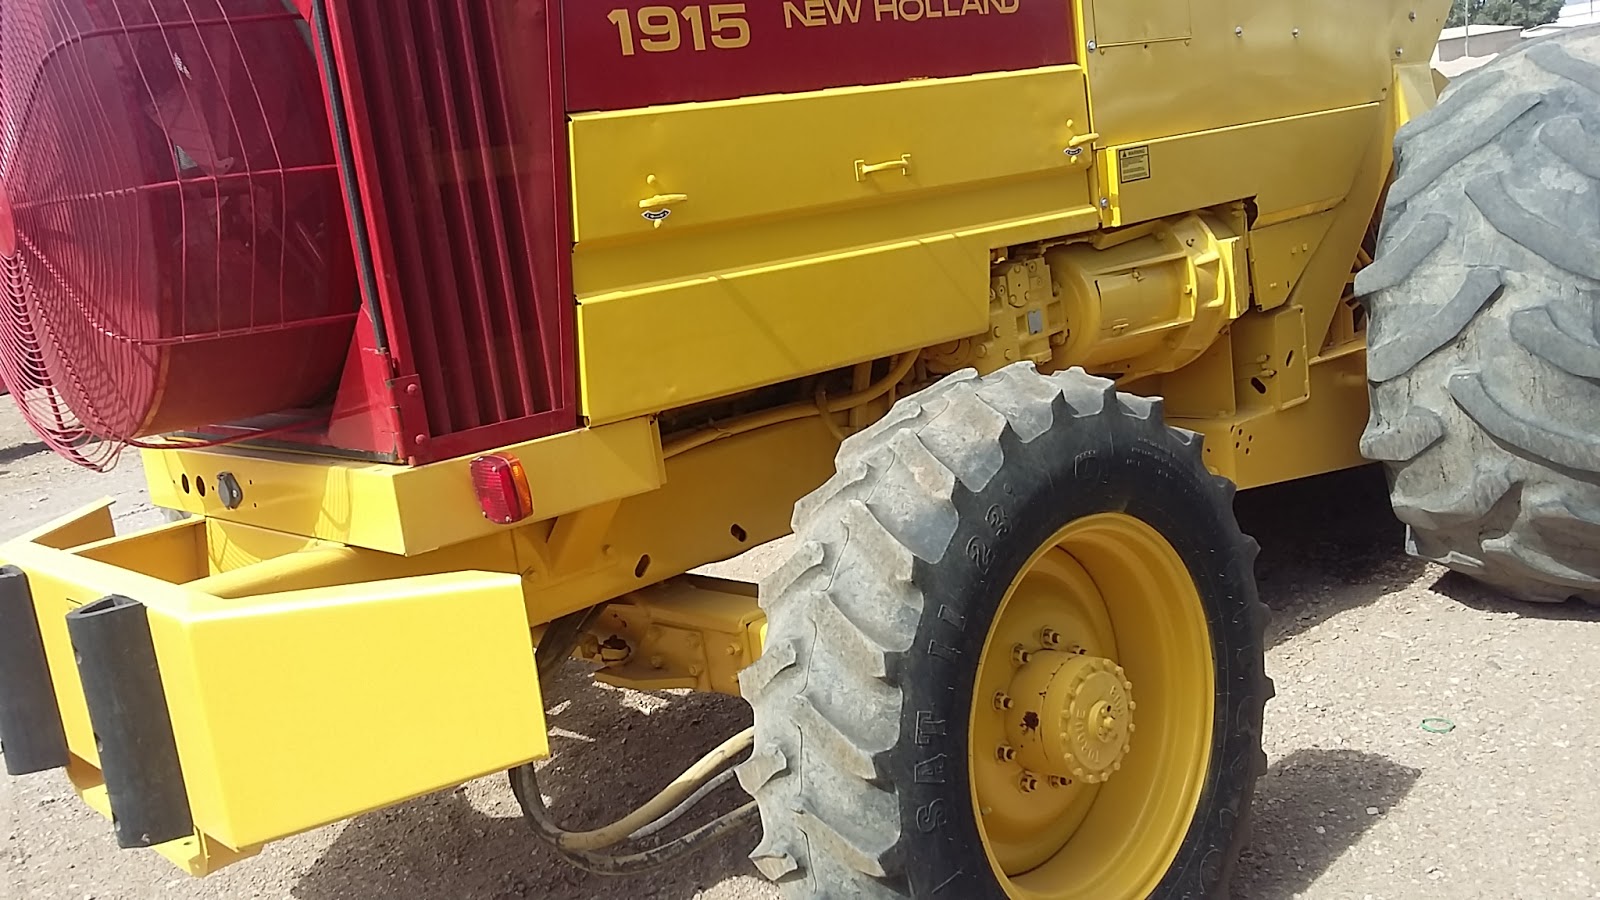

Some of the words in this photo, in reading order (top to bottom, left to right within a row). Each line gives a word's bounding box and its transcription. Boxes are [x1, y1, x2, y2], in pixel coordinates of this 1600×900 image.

[607, 3, 751, 55] 1915
[783, 0, 861, 28] NEW
[874, 0, 1020, 21] HOLLAND
